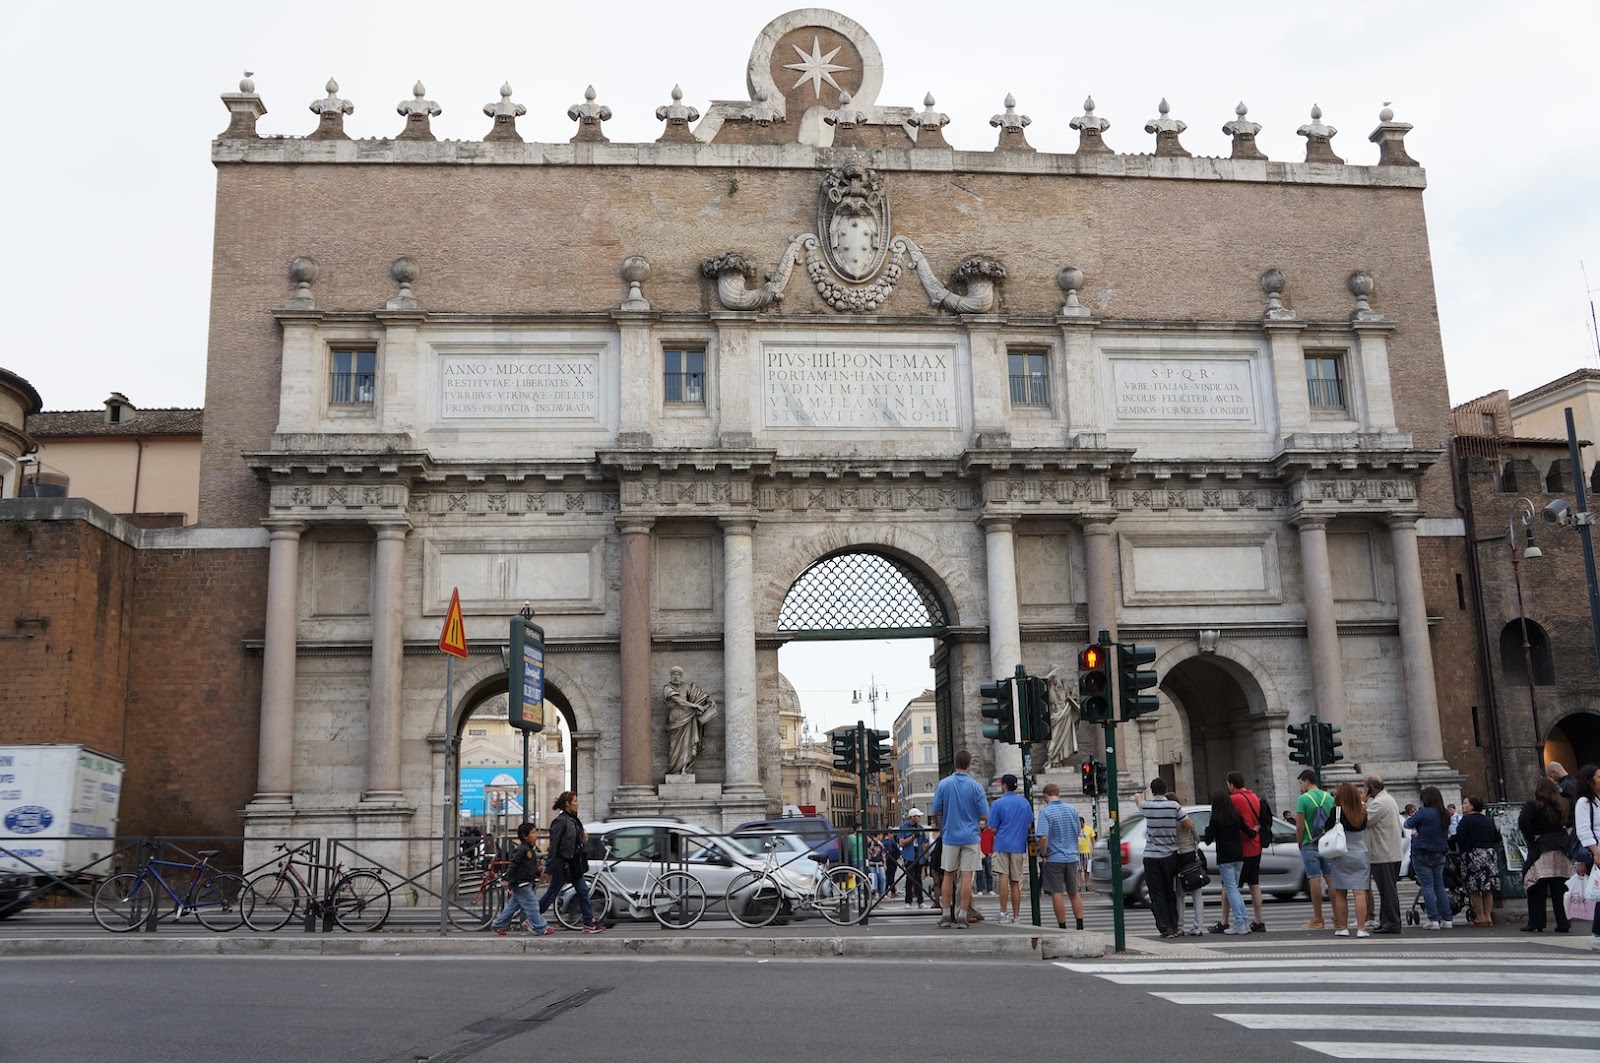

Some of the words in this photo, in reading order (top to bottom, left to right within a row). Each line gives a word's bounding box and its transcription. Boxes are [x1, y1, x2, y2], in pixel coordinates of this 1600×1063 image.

[768, 353, 805, 367] PIVS
[843, 353, 897, 368] PONT
[903, 354, 947, 368] MAX
[445, 364, 486, 374] ANNO
[496, 364, 593, 374] MDCCCLXXIX
[768, 370, 827, 381] PORTAM
[834, 371, 849, 381] IN
[855, 371, 896, 381] HANC
[903, 372, 946, 382] AMPLI
[447, 379, 509, 387] RESTITVTAE
[516, 379, 568, 387] LIBERTATIS
[1124, 382, 1149, 390] VRBE
[1194, 383, 1240, 391] VINDICATA
[770, 384, 851, 394] TVDINEM
[861, 384, 937, 395] EXTVLIT
[442, 391, 492, 399] TVRRIBVS
[499, 391, 547, 401] VTRINQVE
[554, 391, 594, 399] DELETIS
[1122, 394, 1156, 402] INCOLIS
[770, 397, 820, 408] VIAM
[445, 404, 477, 412] FRONS
[483, 404, 530, 412] PRODVCTA
[1117, 406, 1157, 414] GEMINOS
[1162, 406, 1205, 414] FORNICES
[871, 411, 923, 421] ANNO
